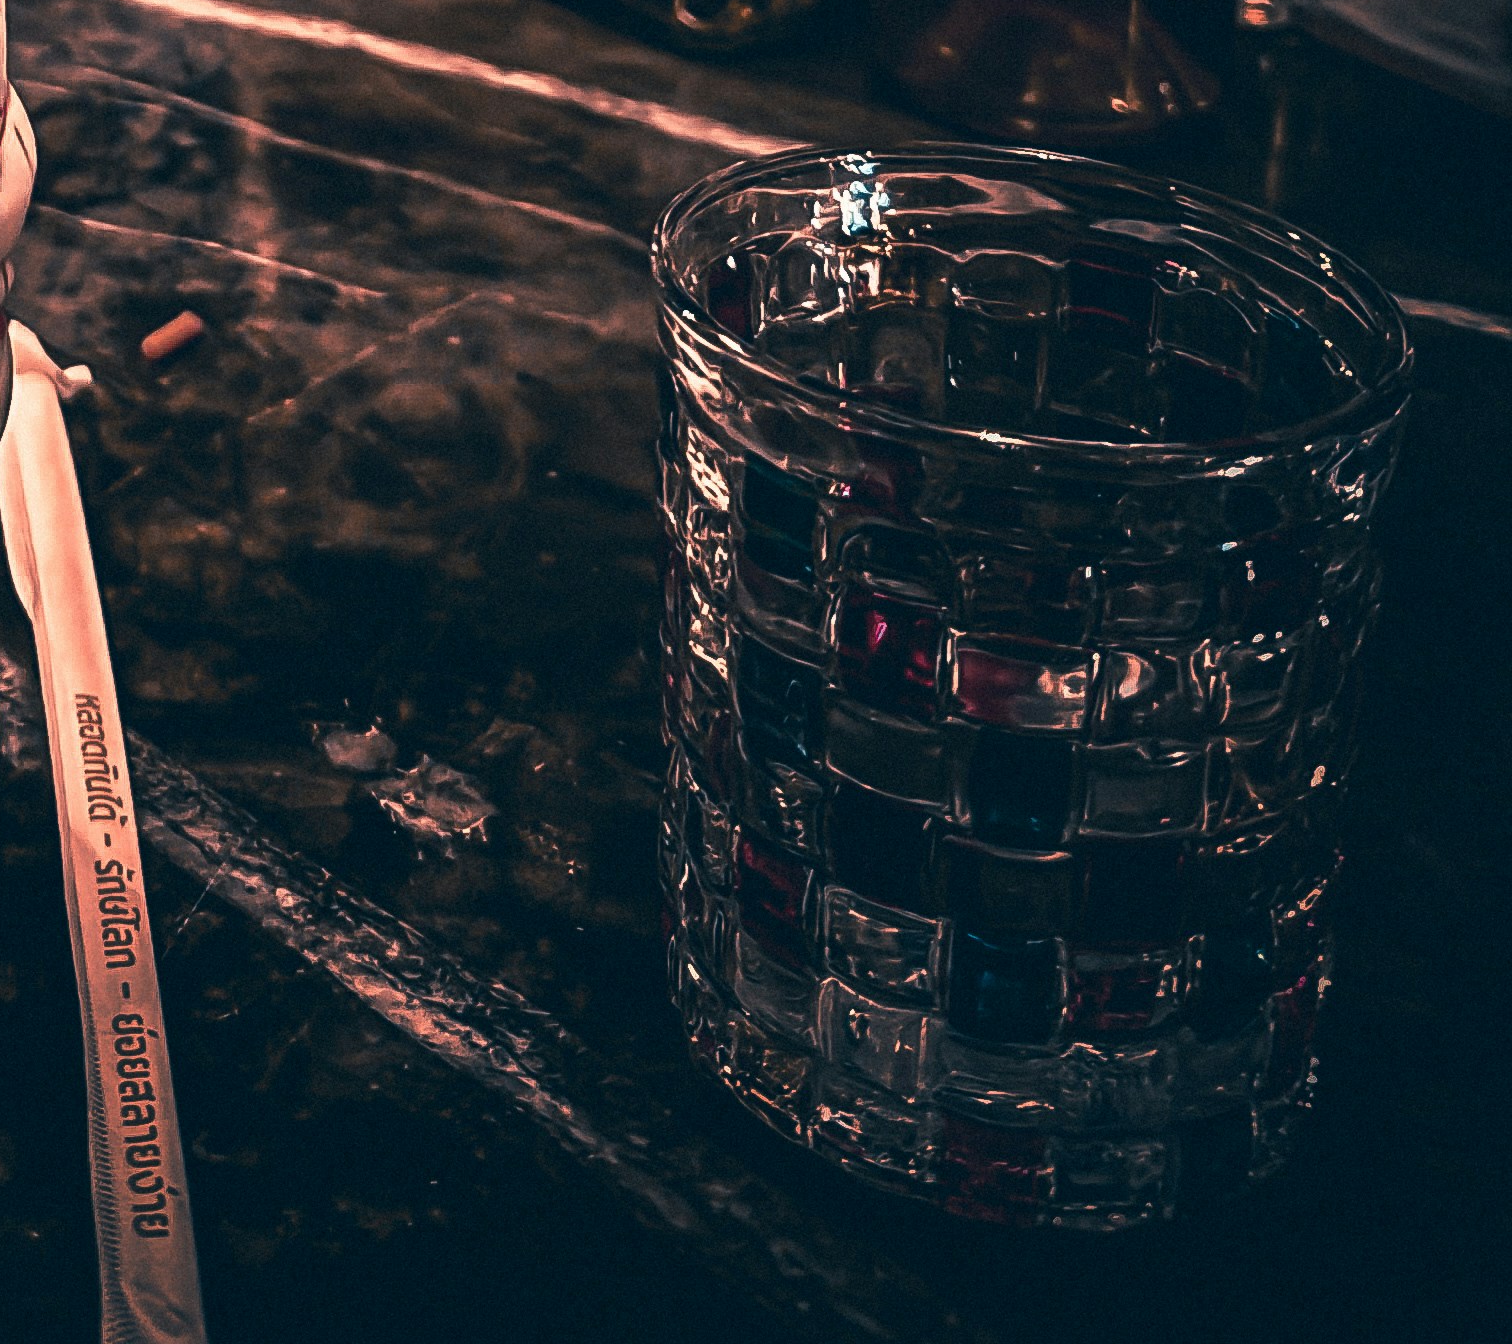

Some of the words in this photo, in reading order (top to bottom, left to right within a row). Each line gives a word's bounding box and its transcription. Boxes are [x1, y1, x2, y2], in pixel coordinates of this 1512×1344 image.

[110, 1012, 181, 1240] ย่อยสลายง่าย
